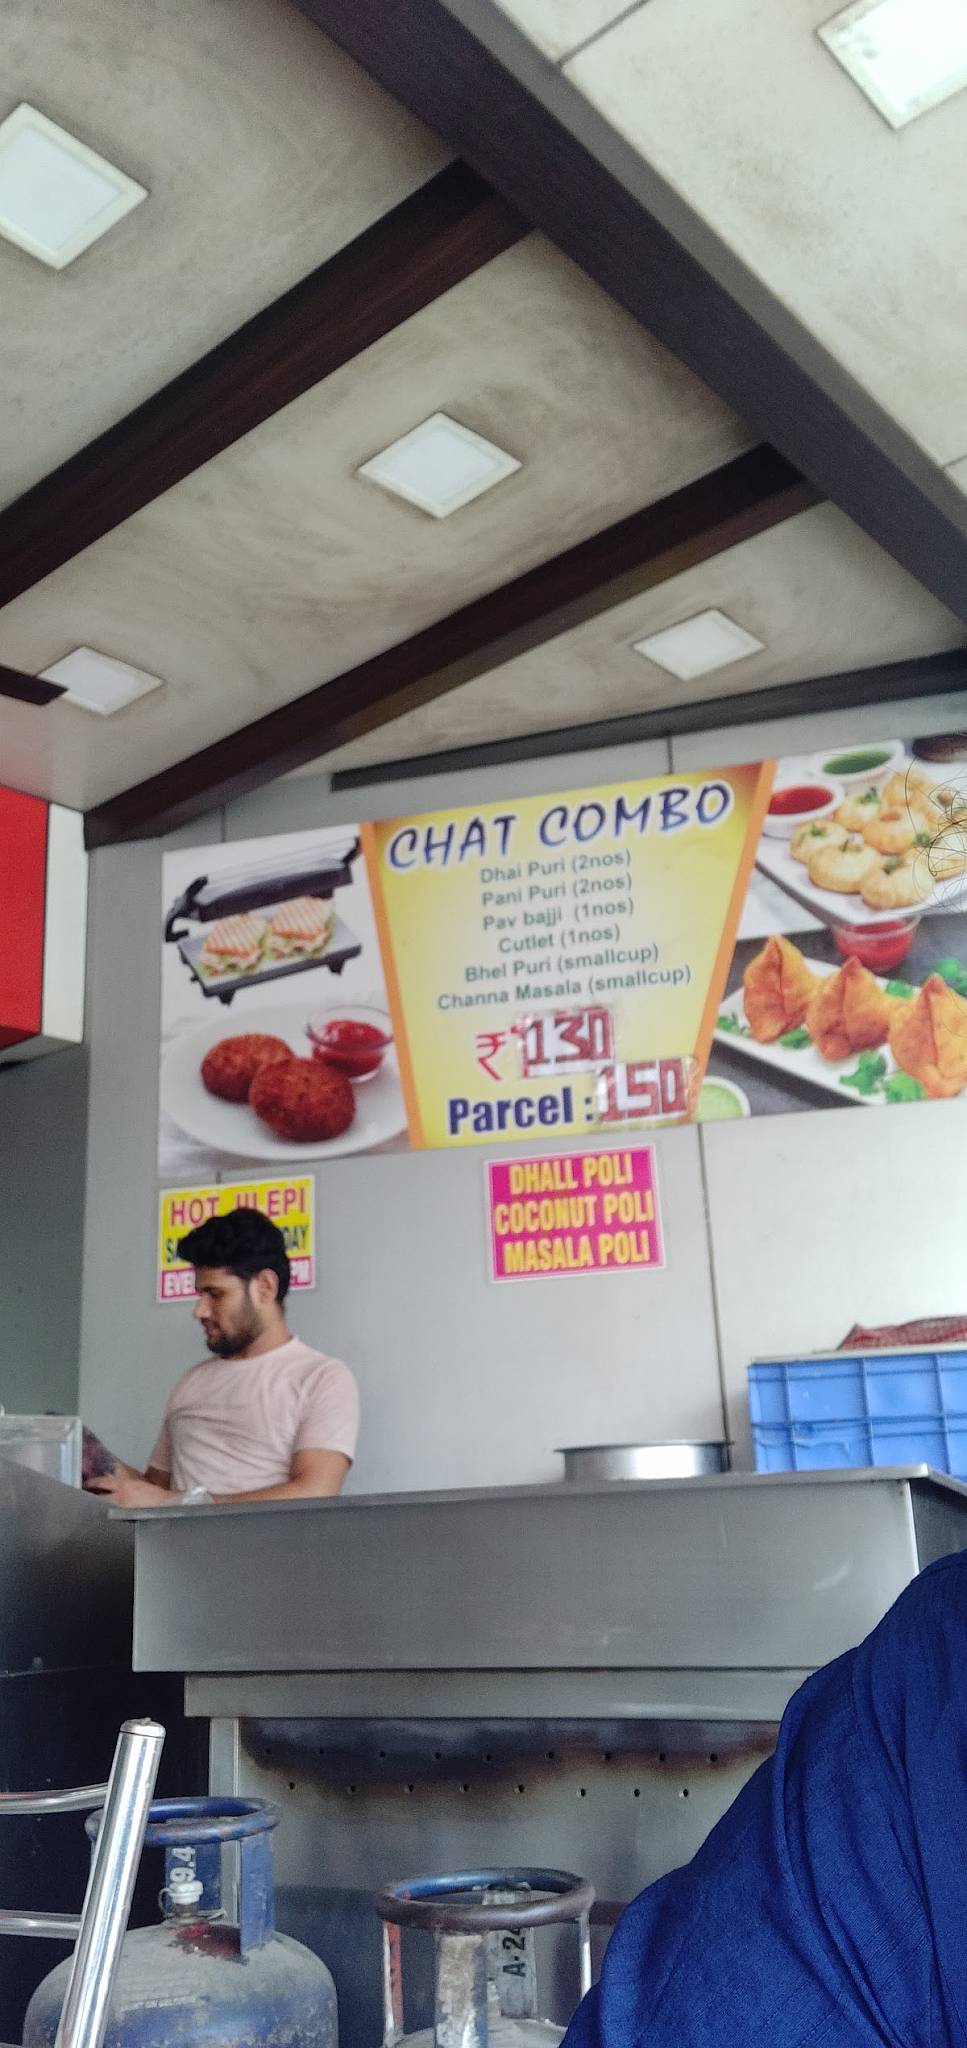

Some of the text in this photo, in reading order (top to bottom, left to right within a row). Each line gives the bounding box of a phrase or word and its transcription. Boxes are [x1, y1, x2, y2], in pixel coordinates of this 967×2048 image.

[388, 782, 731, 869] CHAT COMBO
[480, 848, 632, 884] Dhai Puri (2nos)
[481, 872, 633, 907] Pani Puri (2nos)
[482, 897, 634, 931] Pav bajji (1nos)
[498, 923, 621, 954] Cutlet (1nos)
[465, 942, 659, 983] Bhel Puri (smallcup)
[437, 964, 691, 1010] Channa Masala (smallcup)
[526, 1008, 611, 1065] 130
[449, 1086, 574, 1135] Parcel
[598, 1058, 687, 1122] 150
[509, 1151, 634, 1195] DHALL POLI
[170, 1197, 220, 1226] HOT
[494, 1189, 654, 1236] COCONUT POLI
[504, 1230, 651, 1274] MASALA POLI
